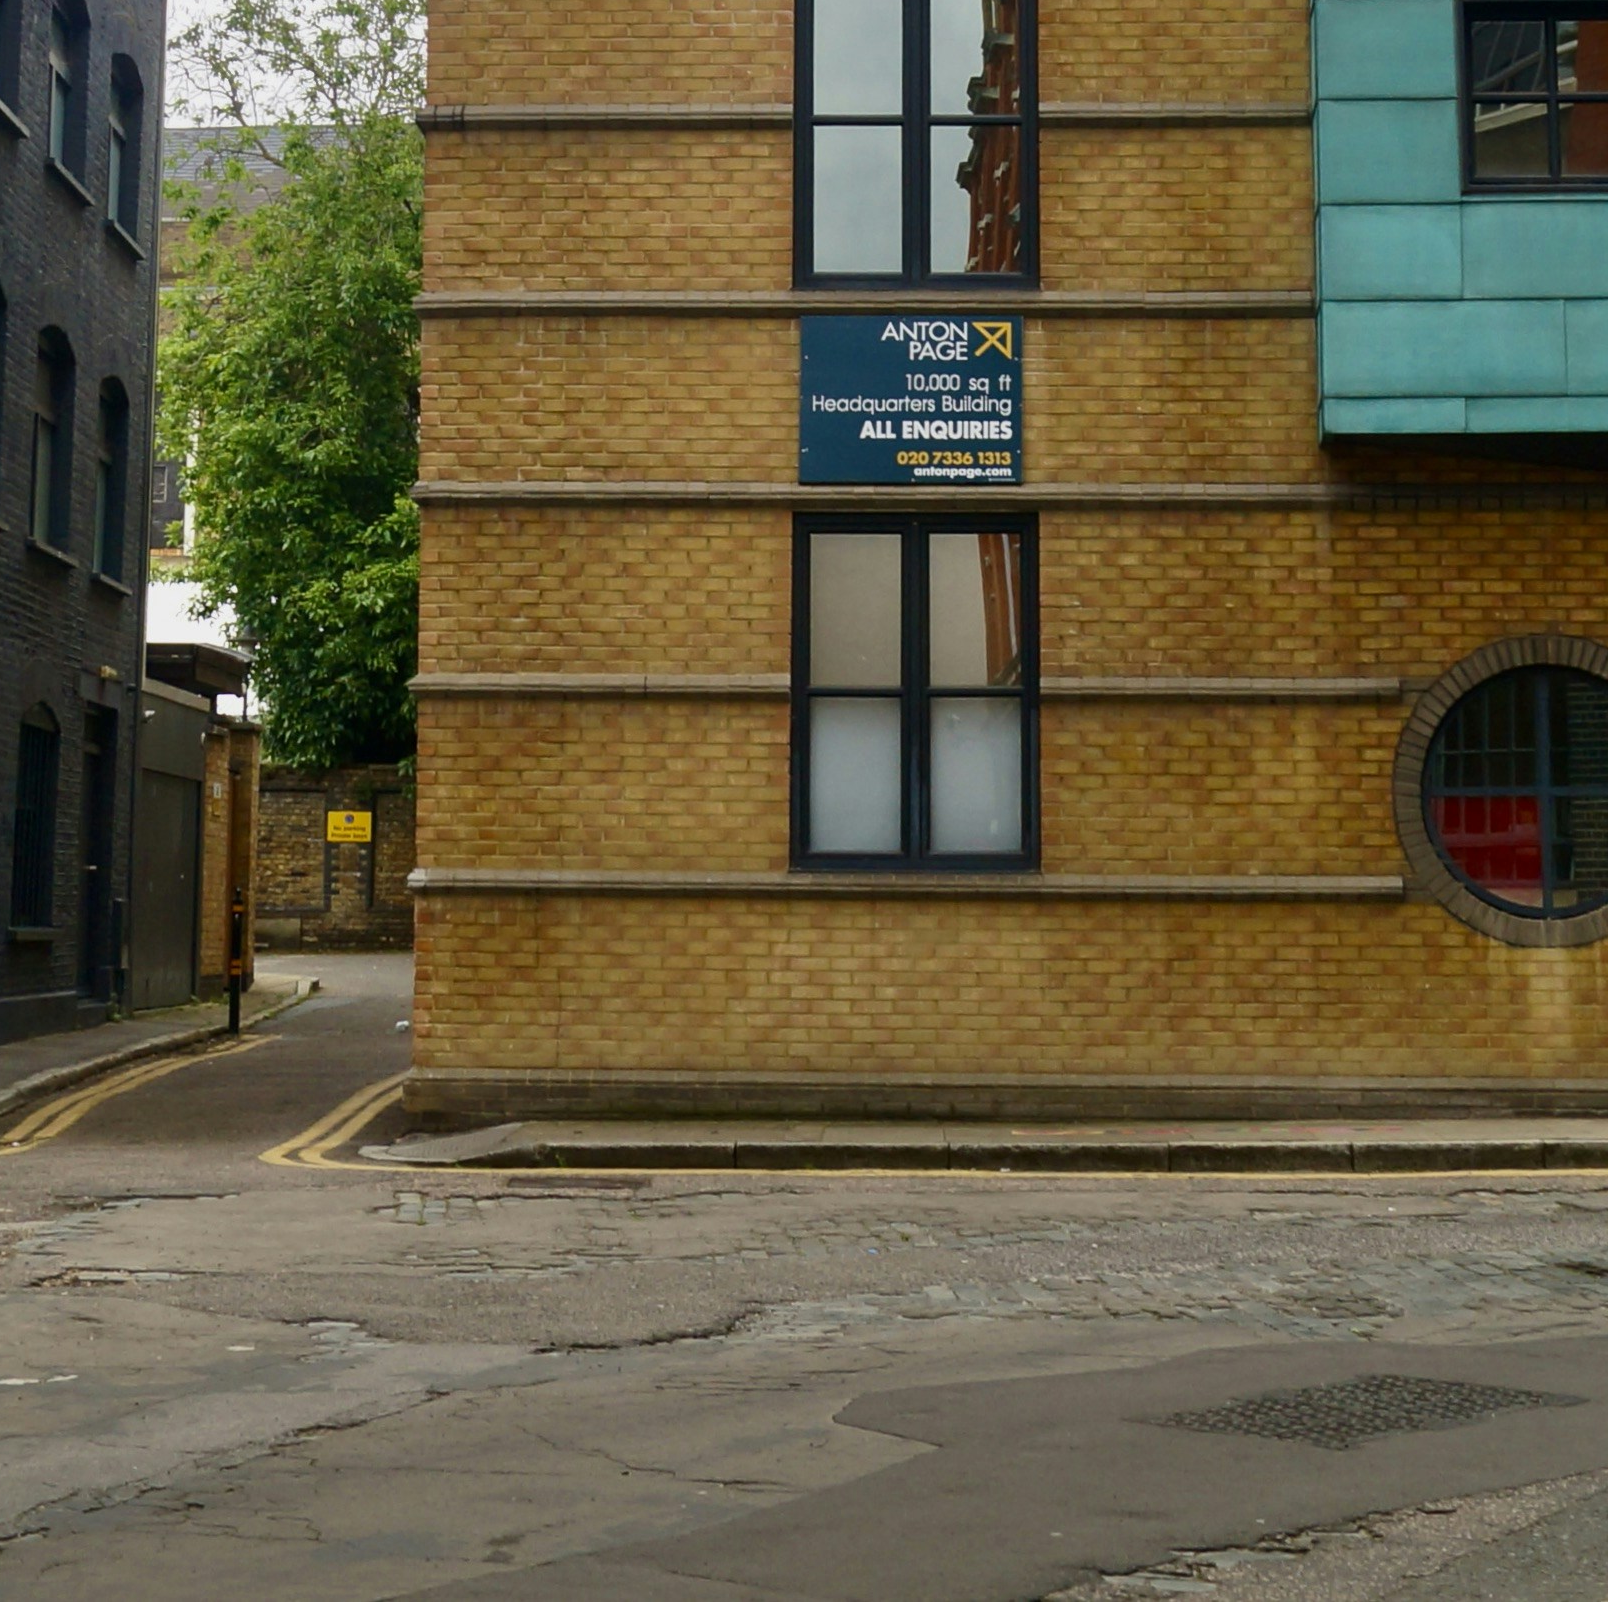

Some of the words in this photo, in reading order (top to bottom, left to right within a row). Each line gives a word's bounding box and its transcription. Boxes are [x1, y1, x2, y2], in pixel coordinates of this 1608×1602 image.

[881, 321, 968, 341] ANTON
[909, 341, 968, 361] PAGE
[906, 374, 960, 392] 10,000
[969, 377, 989, 394] sq
[998, 374, 1011, 391] ft
[812, 395, 936, 415] Headquarters
[942, 395, 1012, 416] Building
[859, 420, 897, 439] ALL
[902, 420, 1012, 440] ENQUIRIES
[897, 452, 929, 465] 020
[933, 452, 973, 465] 7336
[978, 452, 1011, 465] 1313
[914, 466, 1012, 478] antonpage.com
